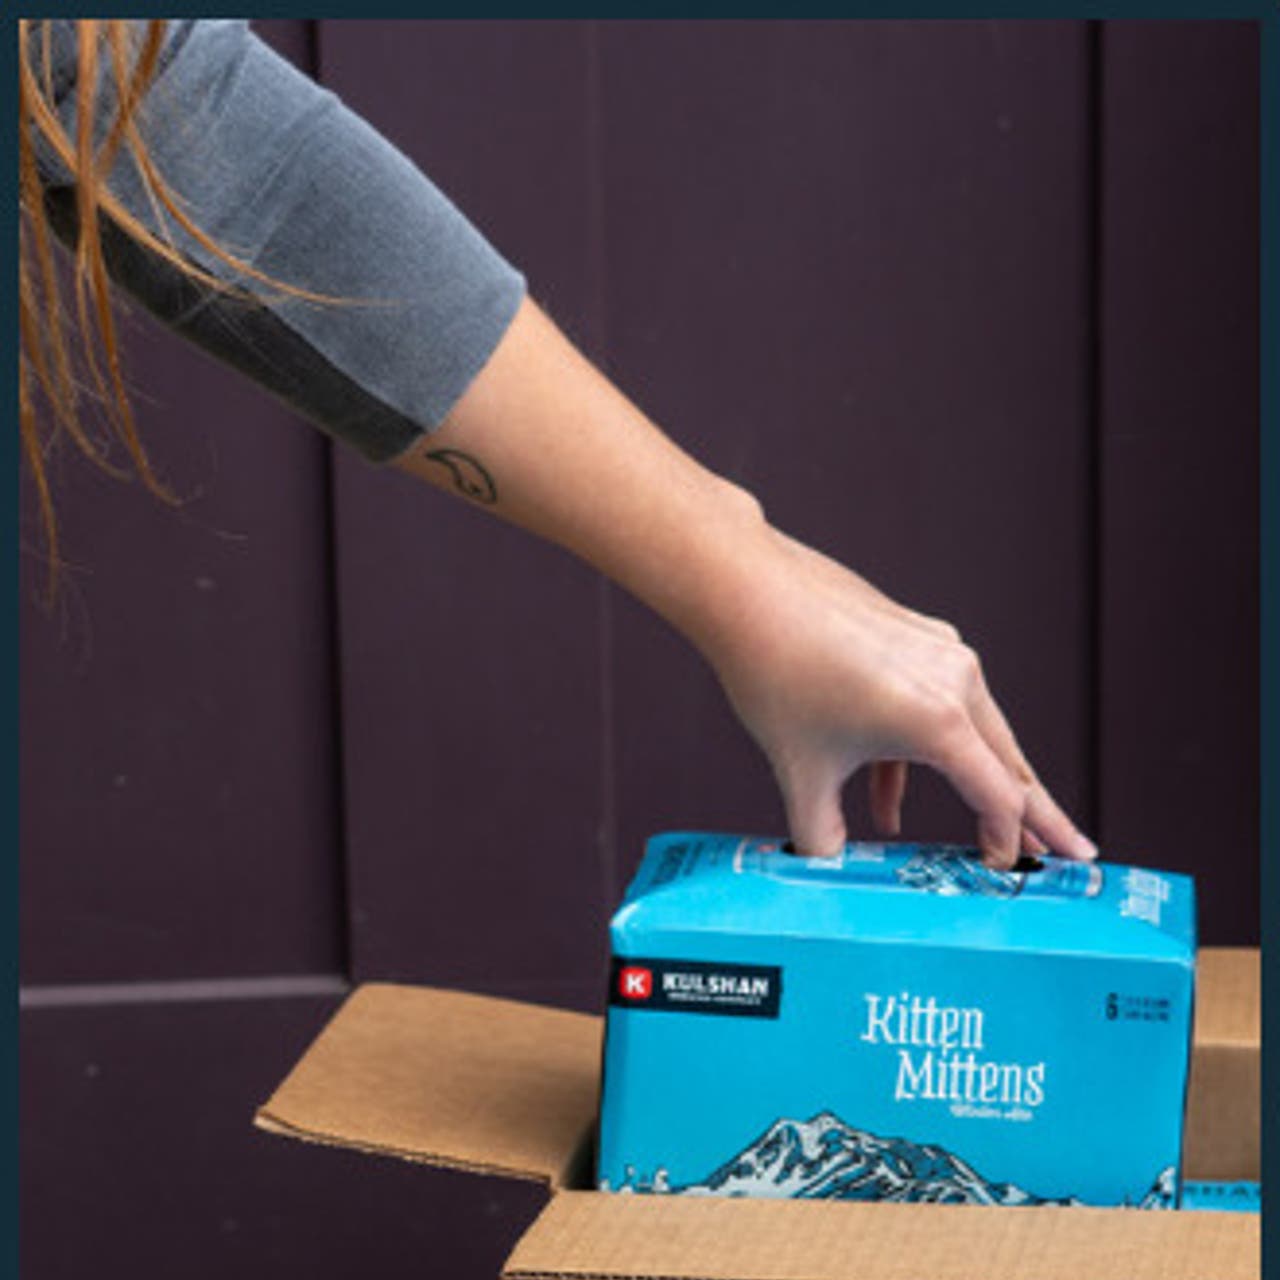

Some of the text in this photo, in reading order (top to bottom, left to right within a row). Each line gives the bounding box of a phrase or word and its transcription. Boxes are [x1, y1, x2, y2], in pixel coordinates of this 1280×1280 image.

[662, 972, 770, 996] KULSHAN
[861, 992, 984, 1051] Kitten
[895, 1049, 1046, 1106] Mittens
